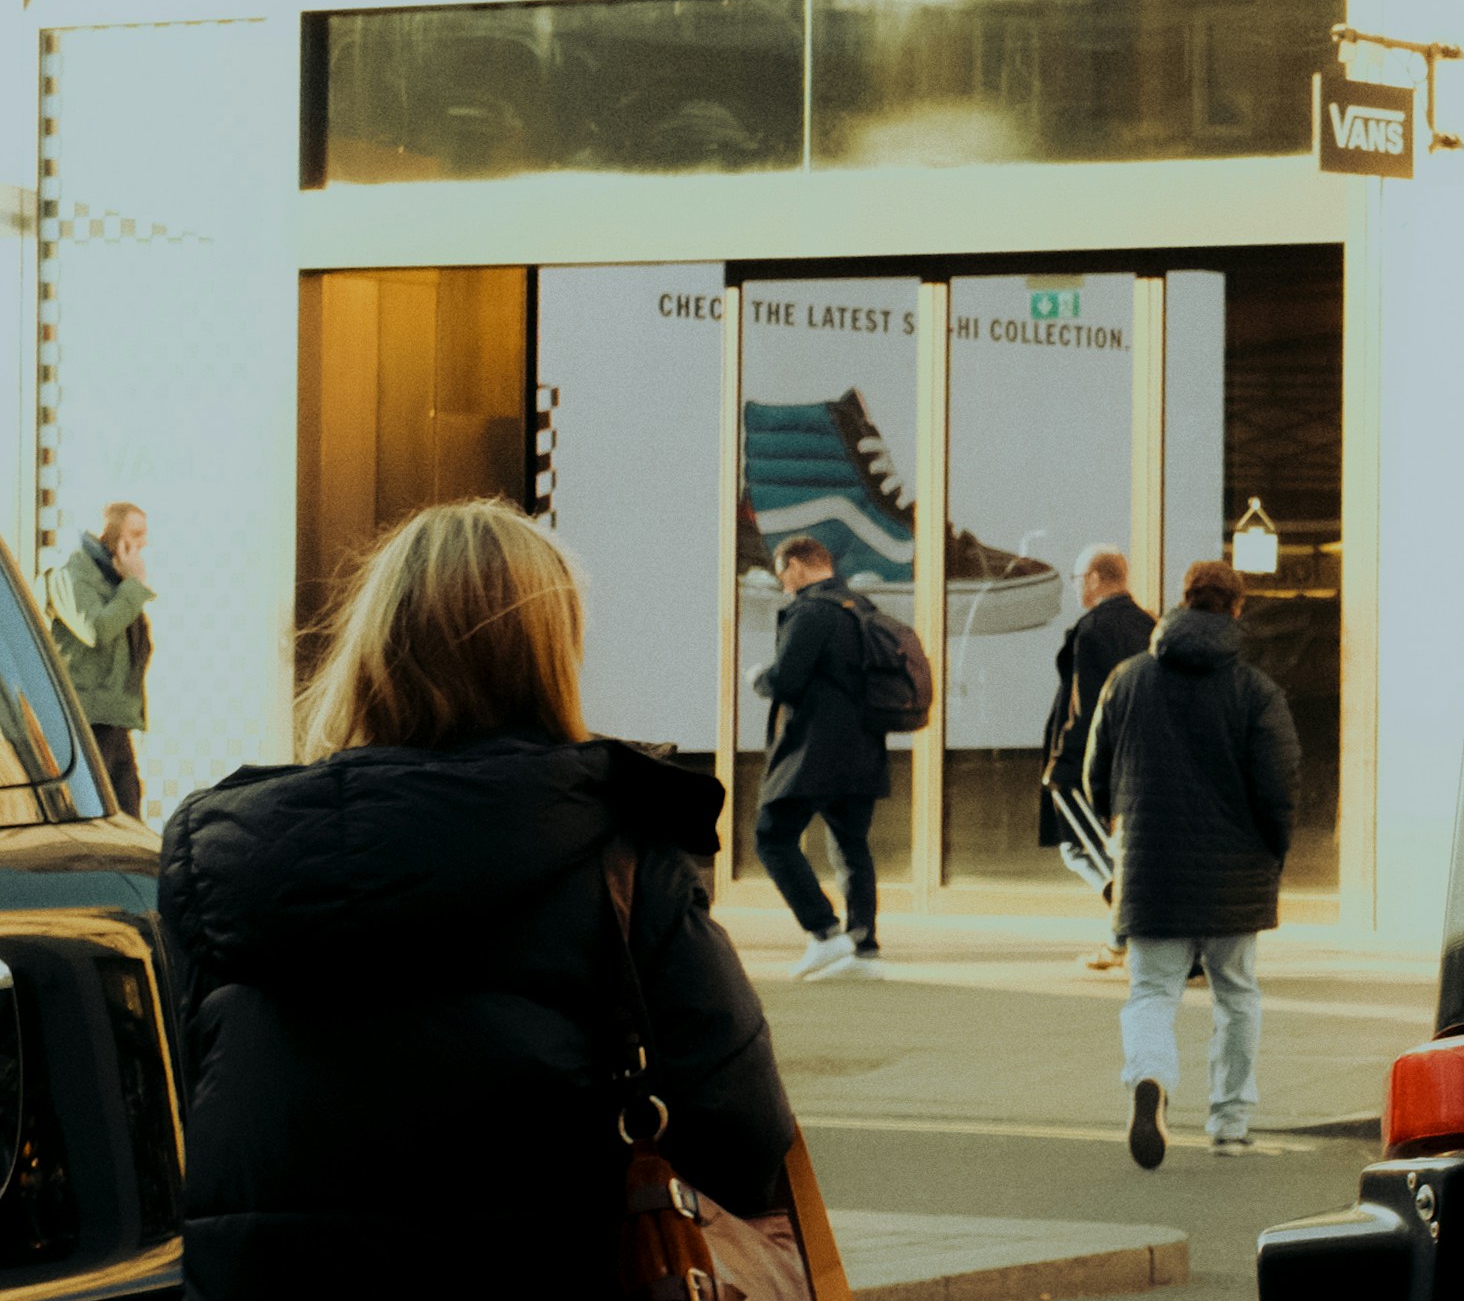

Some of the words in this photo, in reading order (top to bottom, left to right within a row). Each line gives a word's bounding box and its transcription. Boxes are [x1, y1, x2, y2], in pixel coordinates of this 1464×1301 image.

[1328, 102, 1406, 156] VANS
[658, 294, 726, 323] CHEC
[751, 300, 796, 328] THE
[808, 305, 902, 336] LATEST
[989, 319, 1131, 353] COLLECTION.
